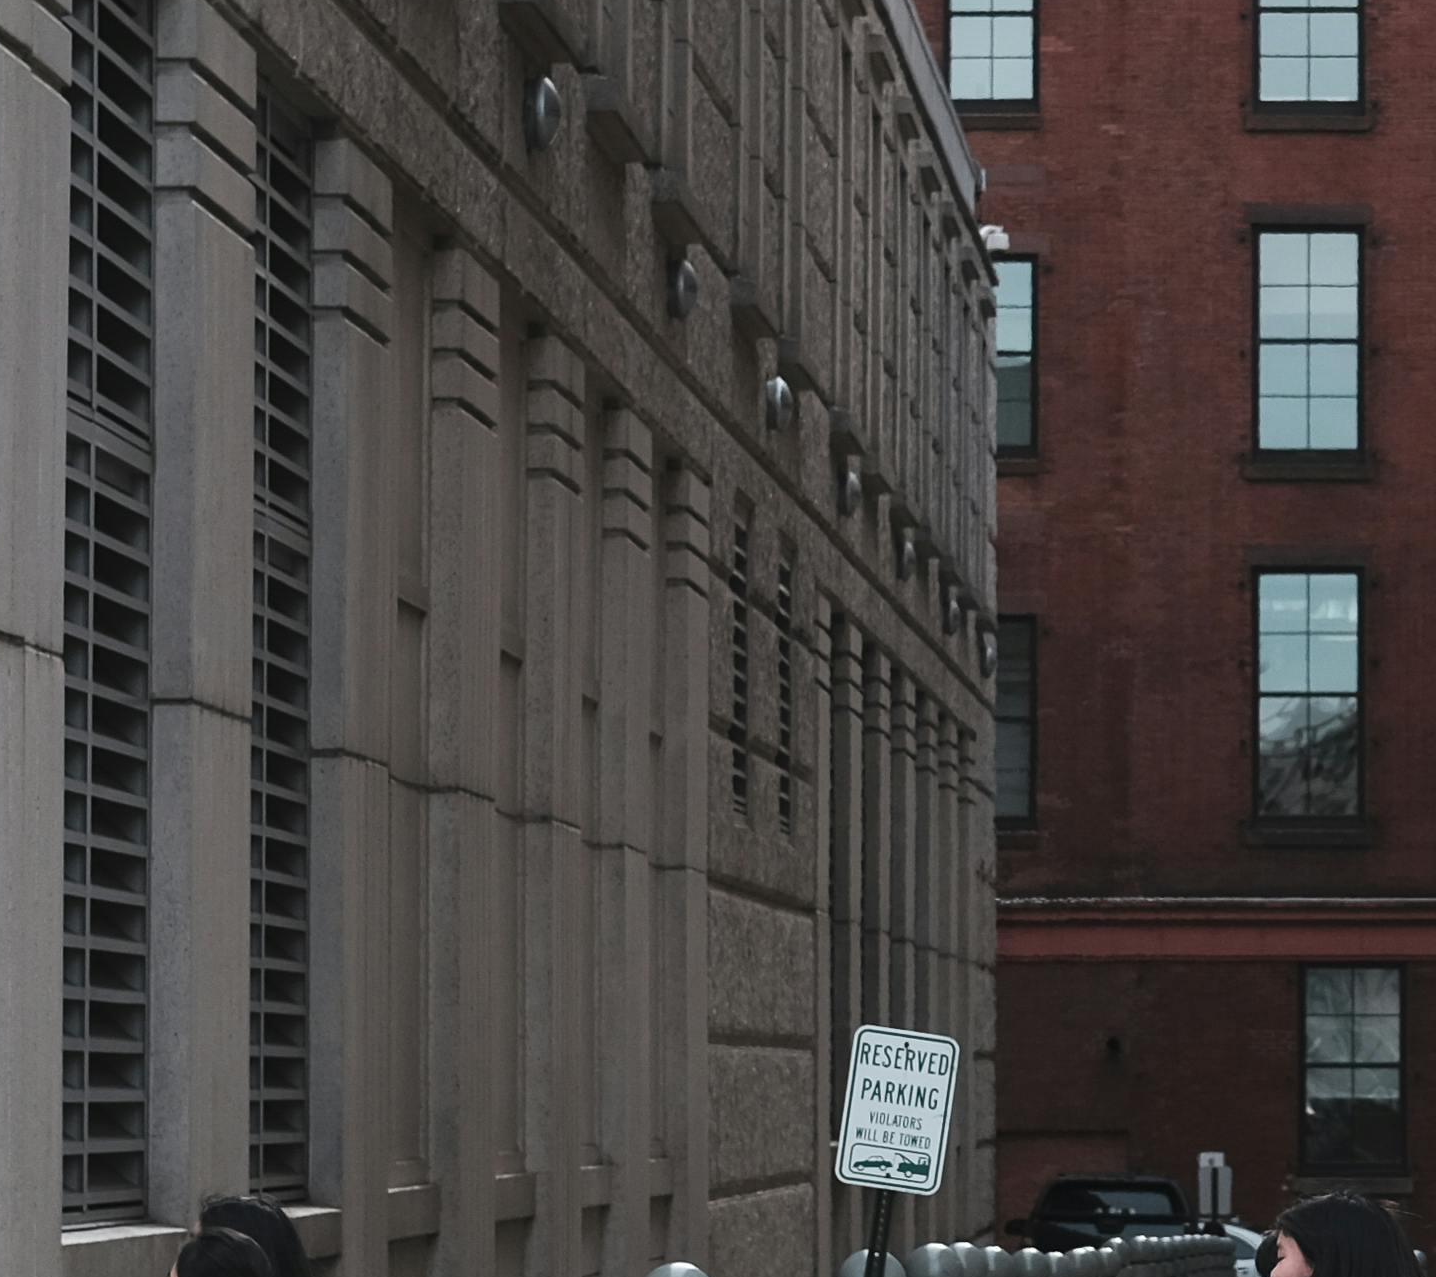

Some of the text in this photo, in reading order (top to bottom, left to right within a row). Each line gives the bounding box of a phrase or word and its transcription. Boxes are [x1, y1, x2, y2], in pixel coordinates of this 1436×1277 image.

[860, 1042, 949, 1076] RESERVED
[860, 1078, 939, 1110] PARKING
[869, 1111, 923, 1130] VIOLATORS
[855, 1127, 931, 1149] WILL BE TOWED
